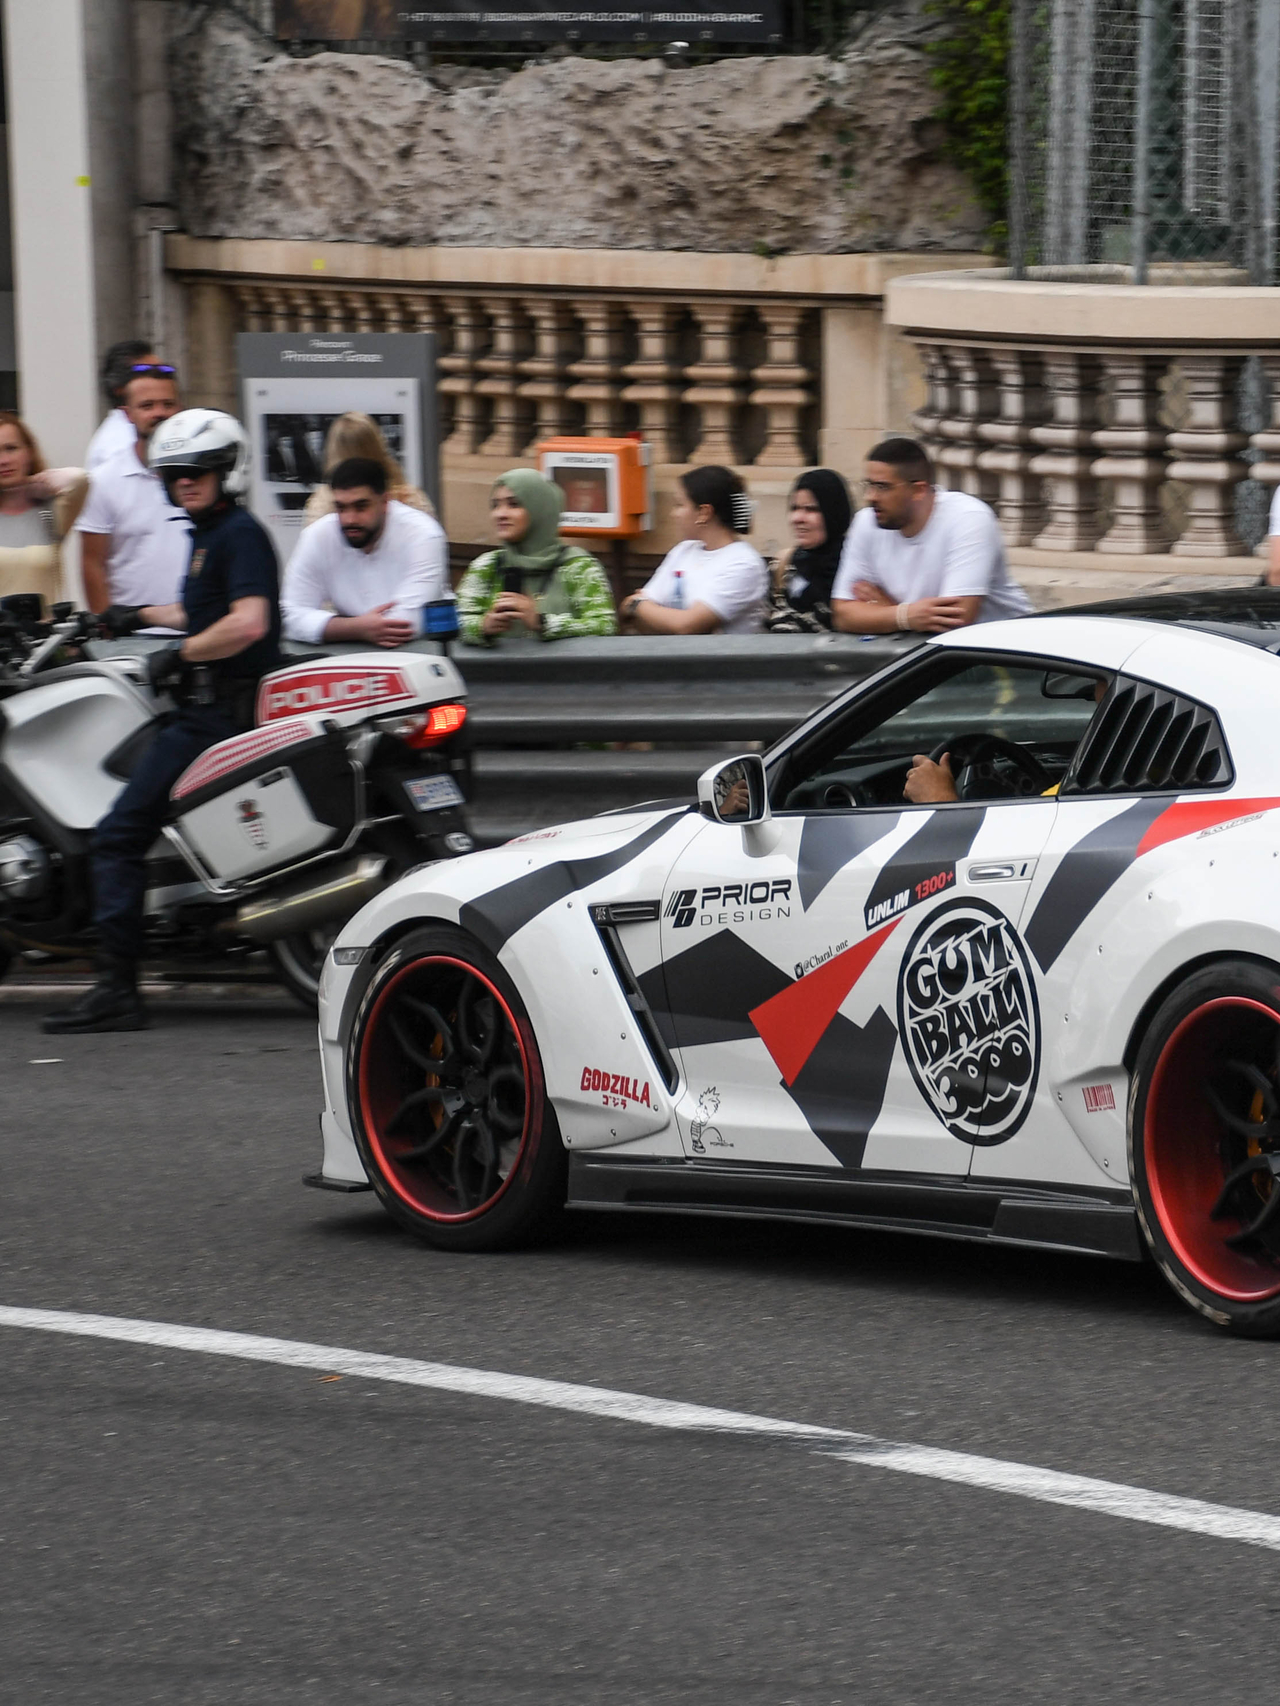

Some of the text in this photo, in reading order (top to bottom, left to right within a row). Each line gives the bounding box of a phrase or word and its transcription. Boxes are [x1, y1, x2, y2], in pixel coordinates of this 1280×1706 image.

[268, 675, 390, 712] POLICE
[701, 879, 792, 909] PRIOR
[867, 870, 954, 926] UNLIM 1300+
[700, 906, 791, 926] DESIGN
[803, 939, 849, 973] @Charal_one
[905, 918, 1014, 1012] GUM
[909, 965, 1030, 1069] BALL
[580, 1066, 650, 1108] GODZILLA
[929, 1031, 1032, 1122] 3000
